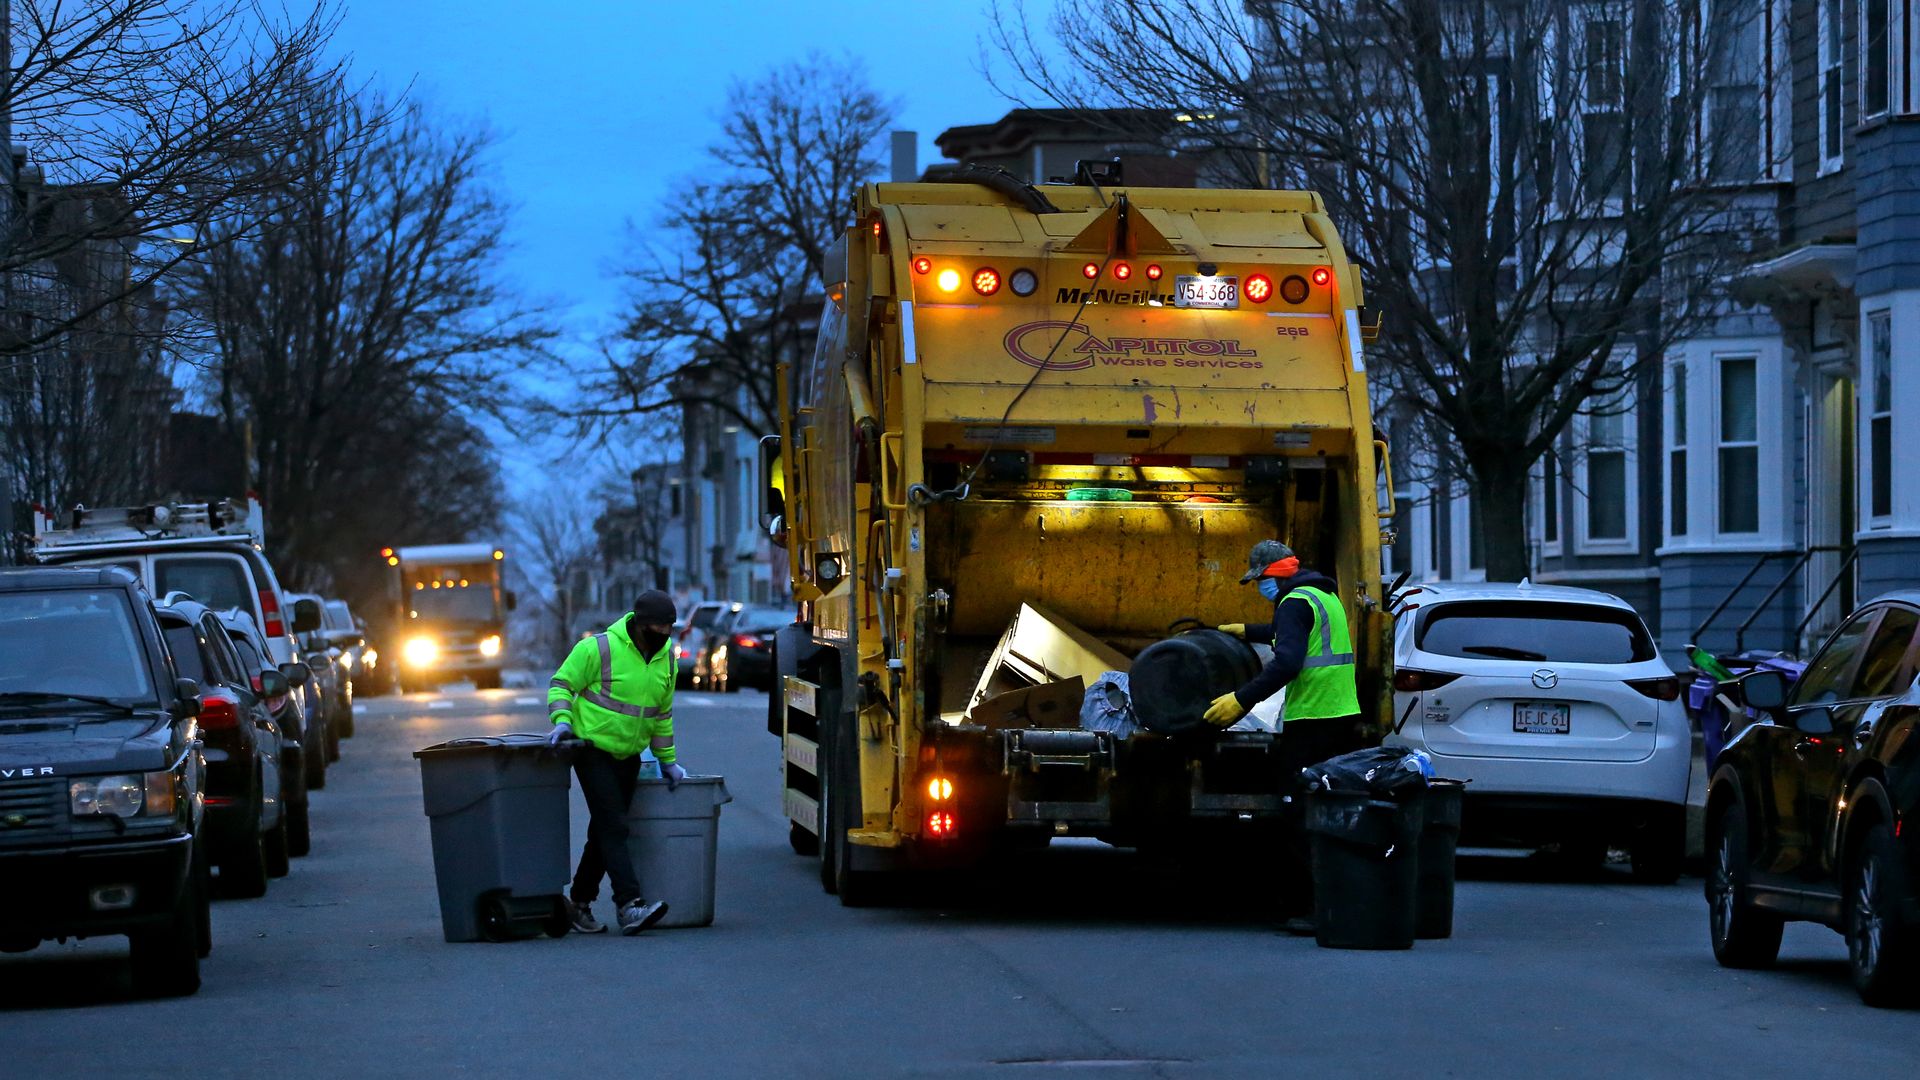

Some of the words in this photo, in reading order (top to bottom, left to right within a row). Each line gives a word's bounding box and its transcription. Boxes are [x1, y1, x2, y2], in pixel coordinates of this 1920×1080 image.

[1003, 320, 1257, 371] CAPITOL
[1099, 356, 1167, 367] Waste
[1174, 357, 1264, 370] Services
[1551, 711, 1566, 726] 61
